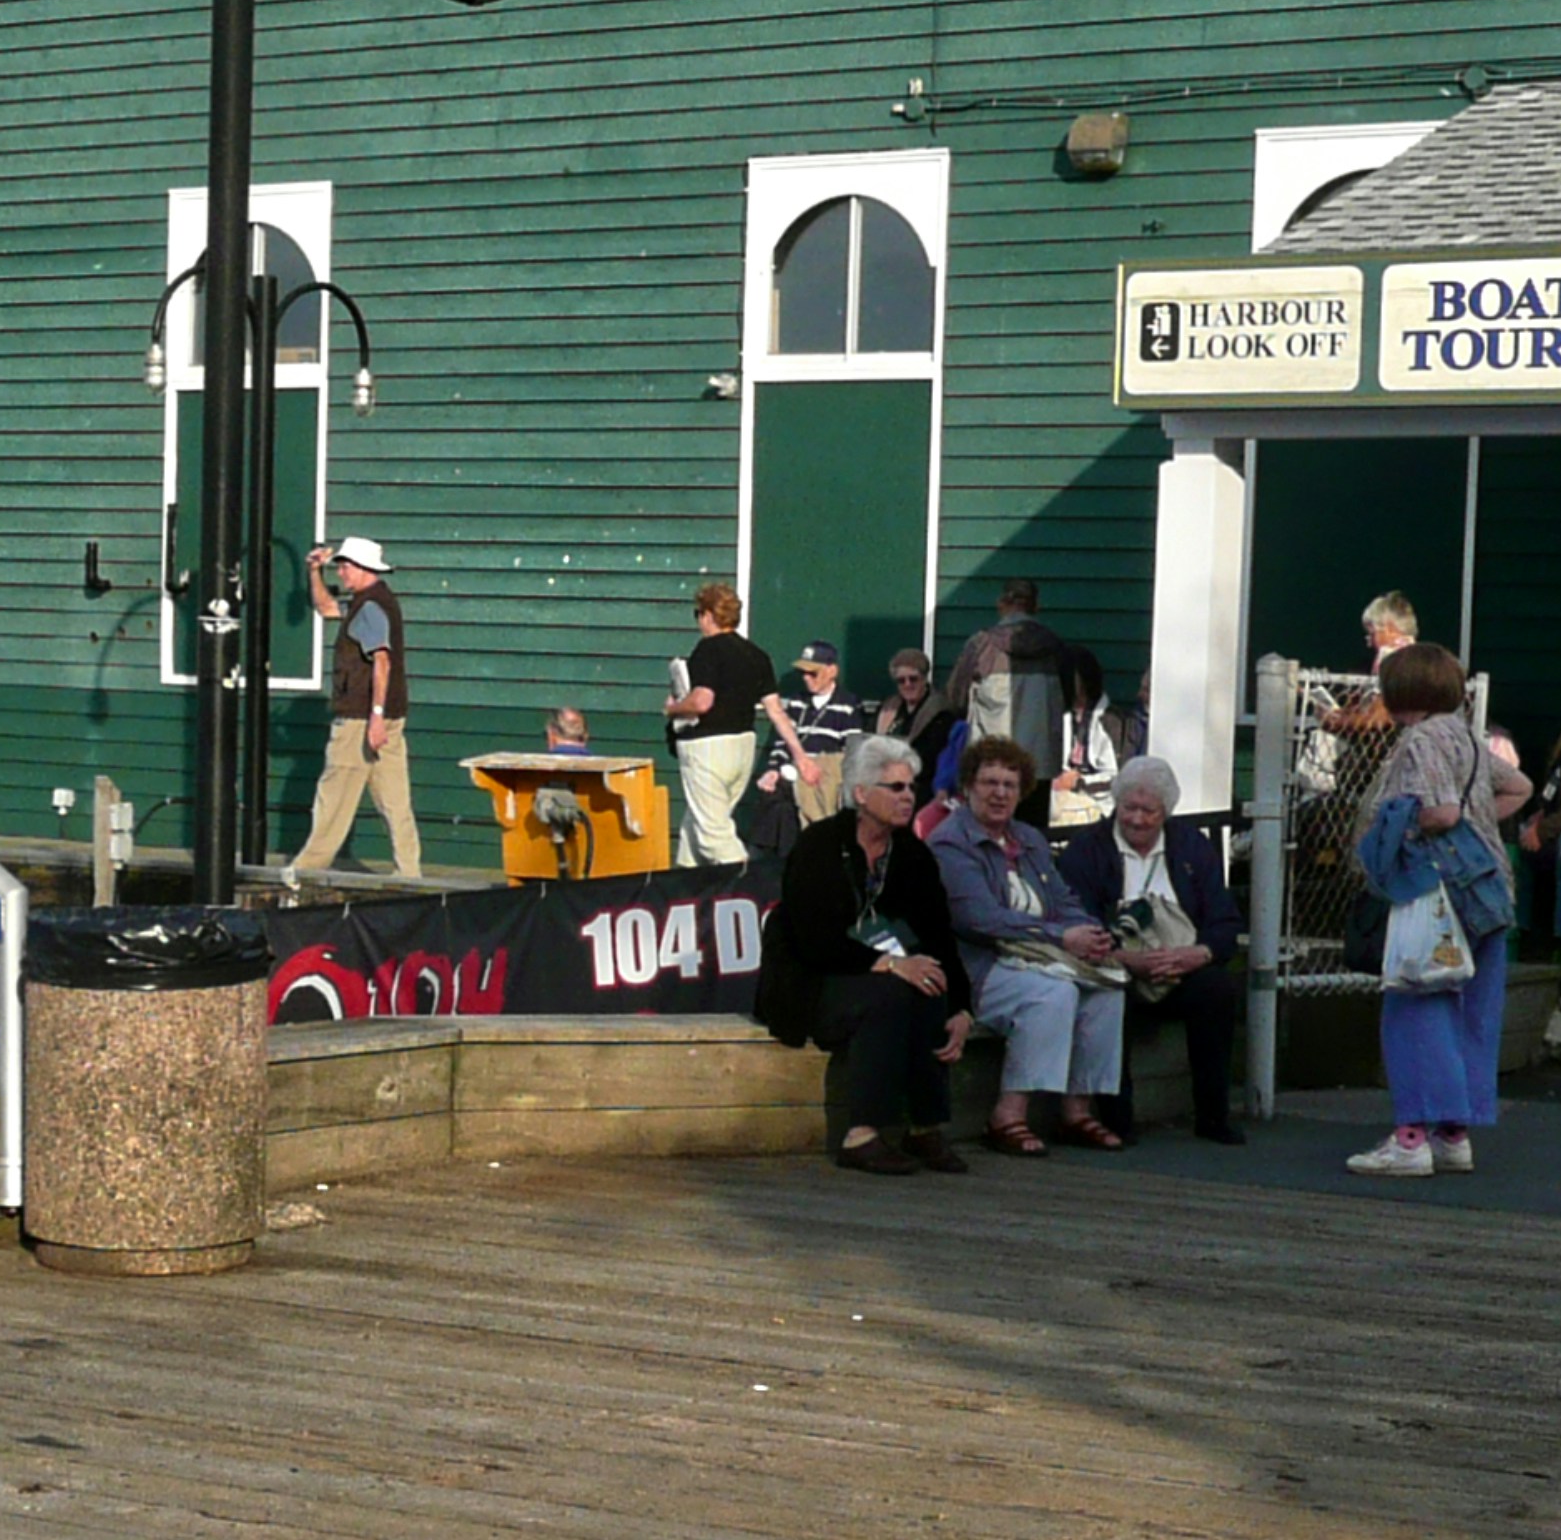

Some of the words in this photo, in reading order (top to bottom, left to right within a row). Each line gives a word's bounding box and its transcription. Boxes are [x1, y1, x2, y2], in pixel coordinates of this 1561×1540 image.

[1188, 299, 1348, 328] HARBOUR
[1187, 332, 1277, 360] LOOK
[1285, 331, 1348, 358] OFF
[581, 903, 703, 987] 104
[713, 897, 781, 975] D
